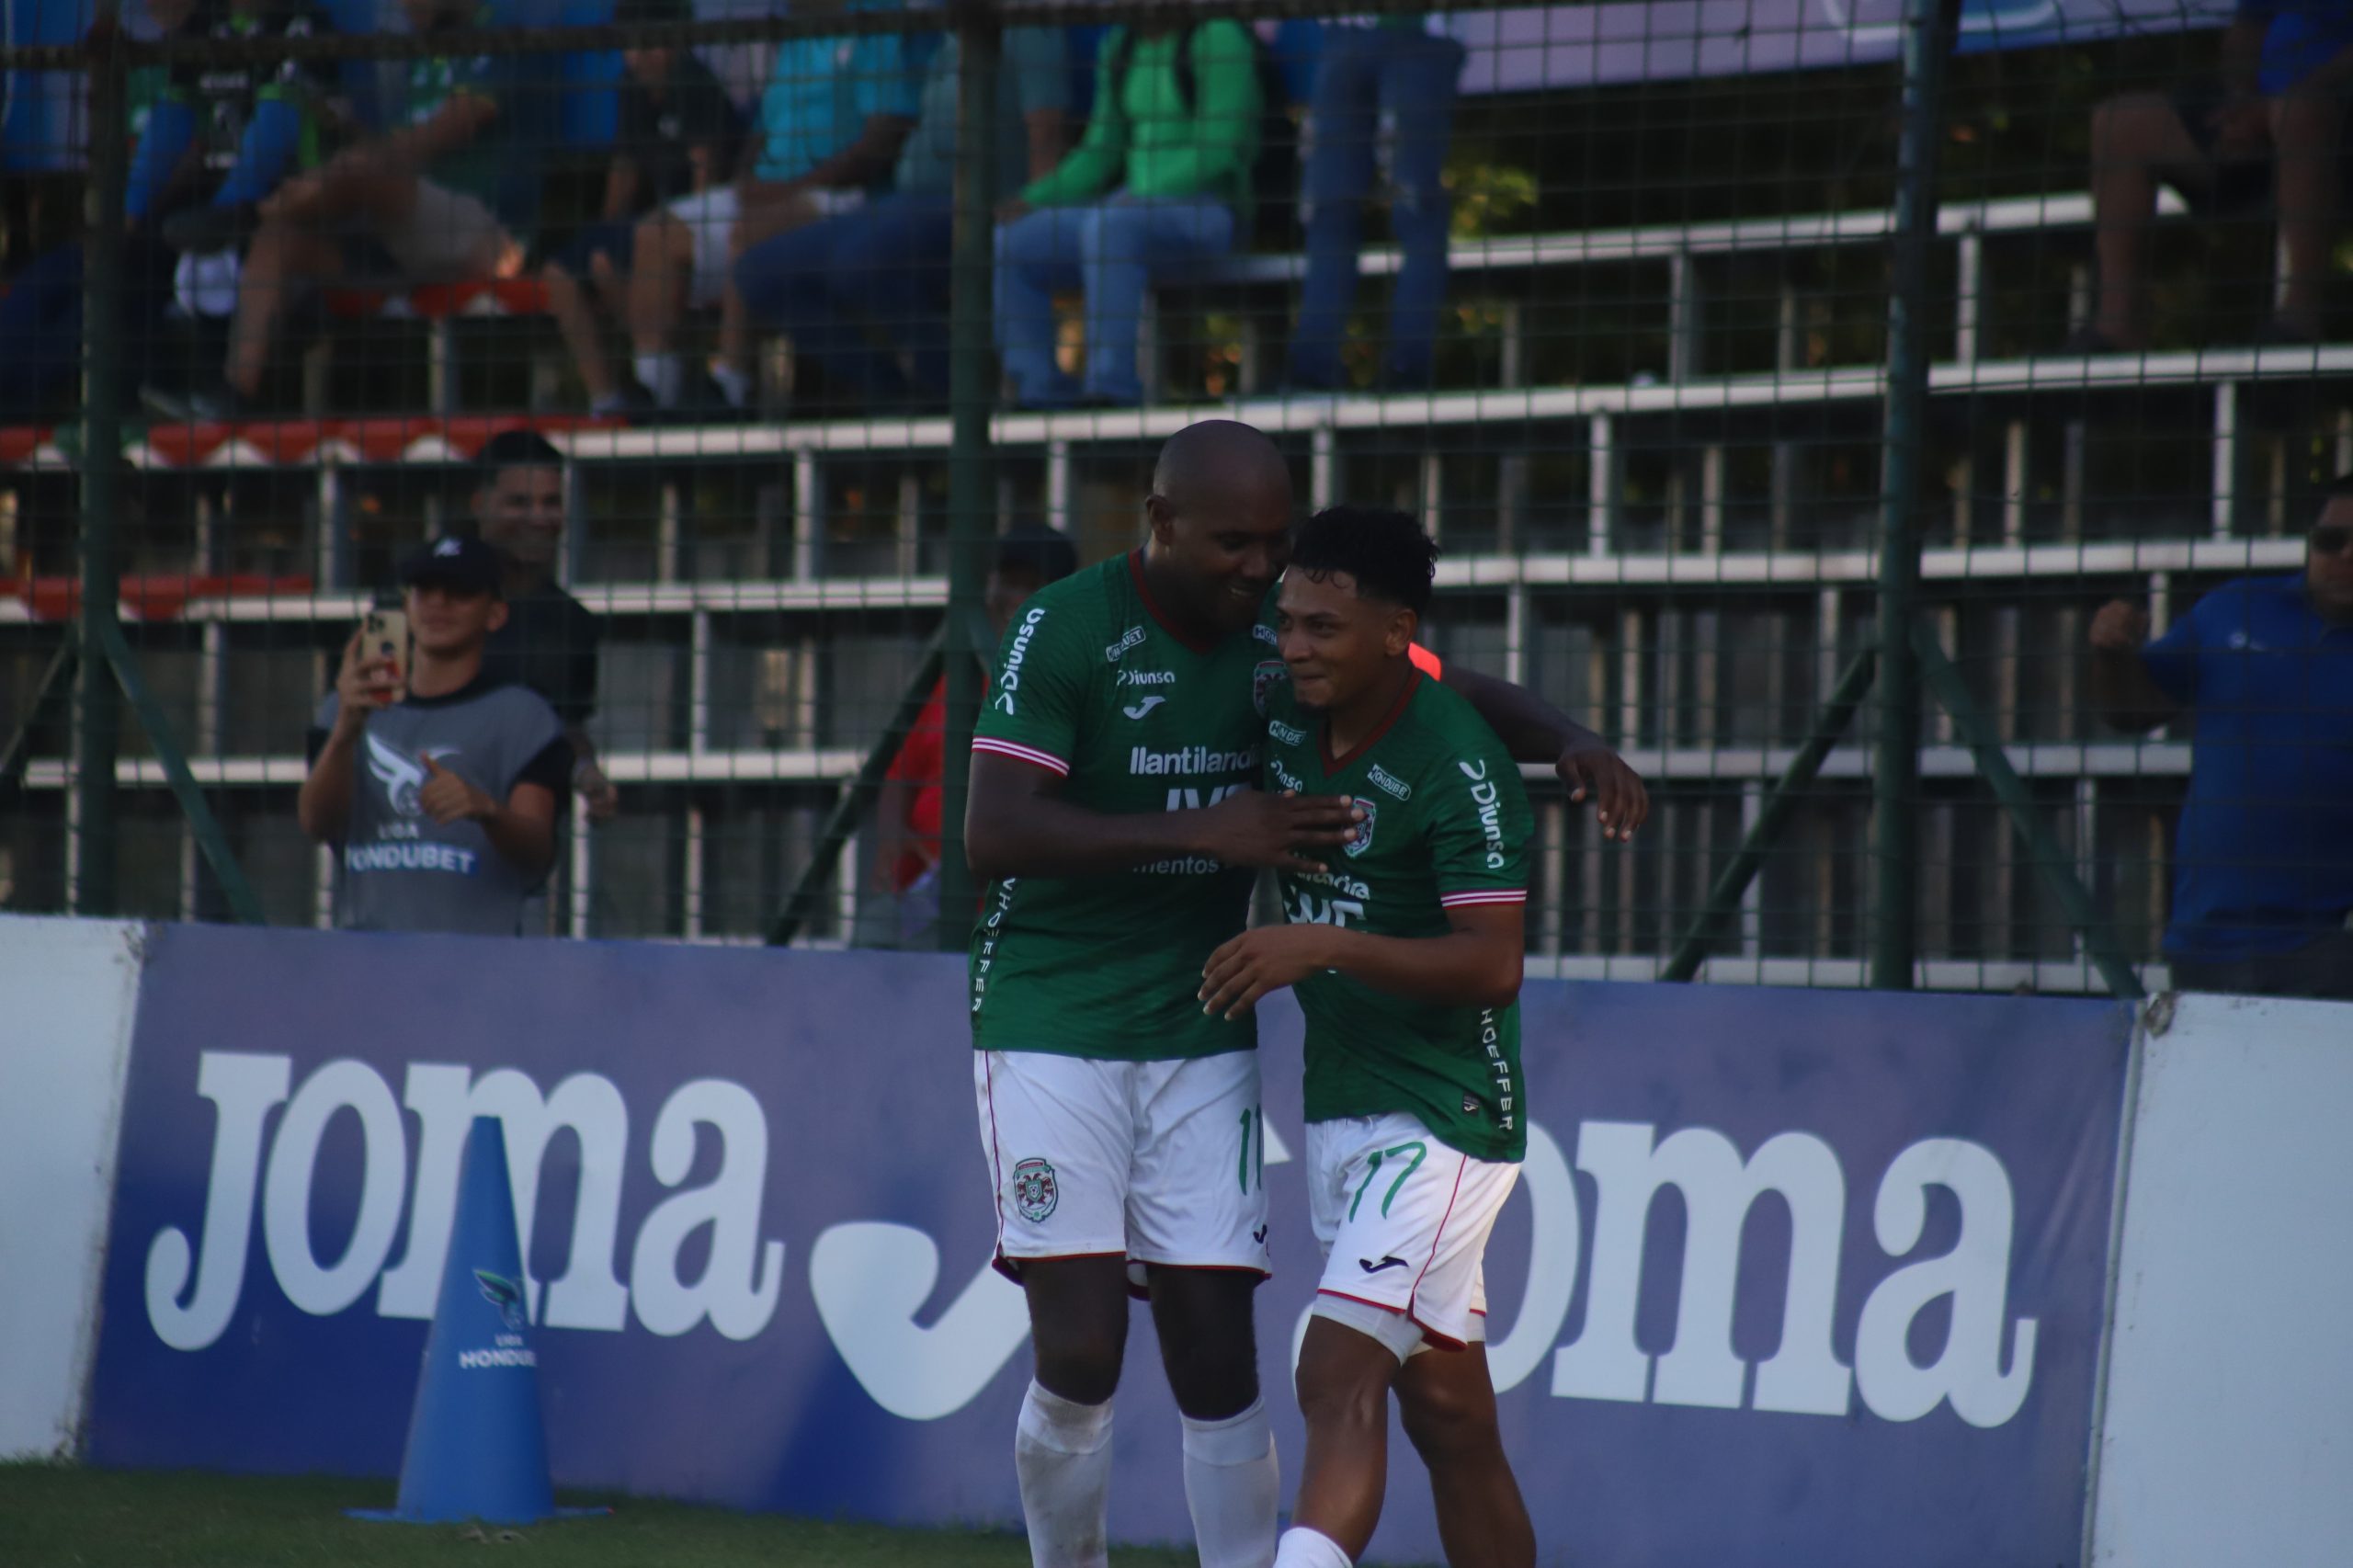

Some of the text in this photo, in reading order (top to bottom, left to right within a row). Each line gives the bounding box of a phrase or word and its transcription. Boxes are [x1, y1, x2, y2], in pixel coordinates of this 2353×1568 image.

[1000, 608, 1045, 691] Diunsa
[1471, 780, 1505, 869] Diunsa
[1348, 1141, 1427, 1224] 17
[1291, 1119, 2038, 1428] oma
